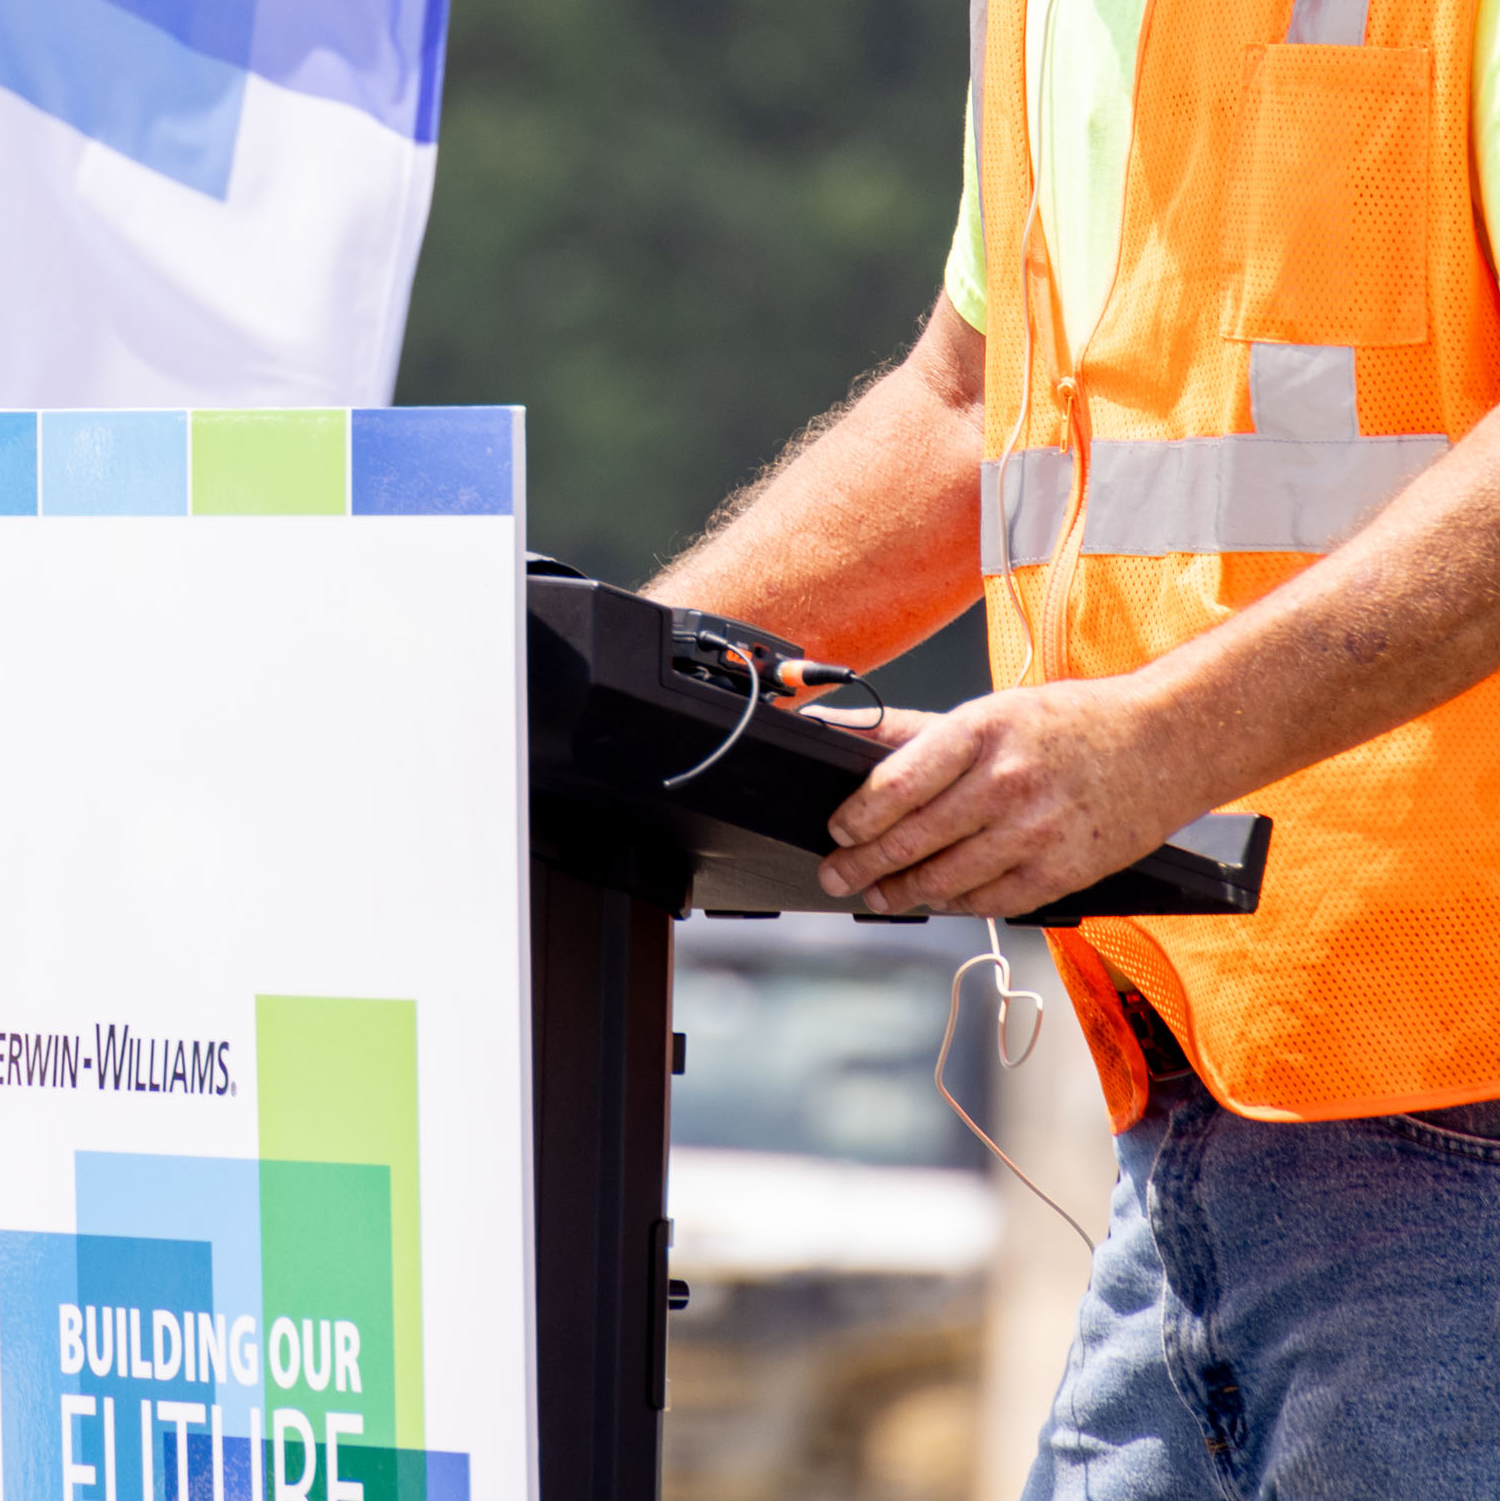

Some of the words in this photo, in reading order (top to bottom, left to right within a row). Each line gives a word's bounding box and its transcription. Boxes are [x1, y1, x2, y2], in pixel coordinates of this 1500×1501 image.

[58, 1303, 258, 1386] BUILDING
[268, 1316, 362, 1393] OUR
[60, 1394, 364, 1501] FUTURE
